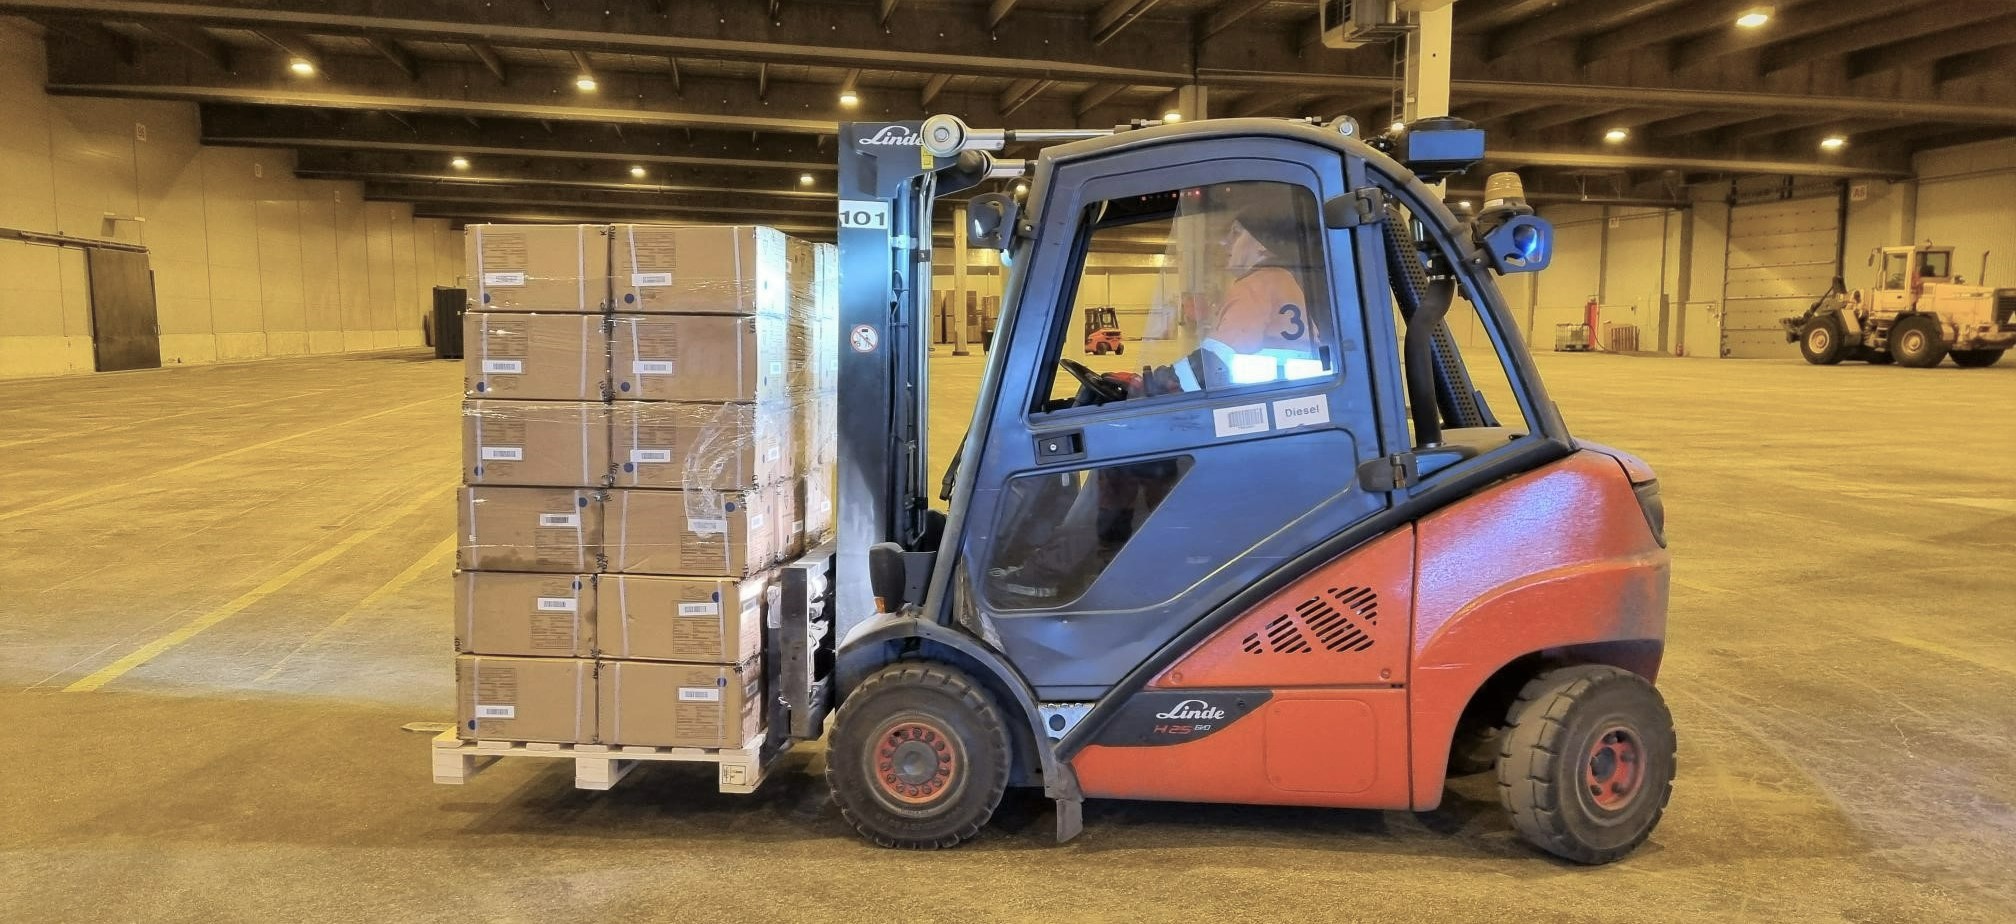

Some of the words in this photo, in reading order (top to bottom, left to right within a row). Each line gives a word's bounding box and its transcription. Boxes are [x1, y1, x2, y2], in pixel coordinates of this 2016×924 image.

[840, 210, 885, 226] 101
[1278, 303, 1305, 341] 3
[1285, 404, 1320, 418] Diesel
[1156, 699, 1225, 720] Linde
